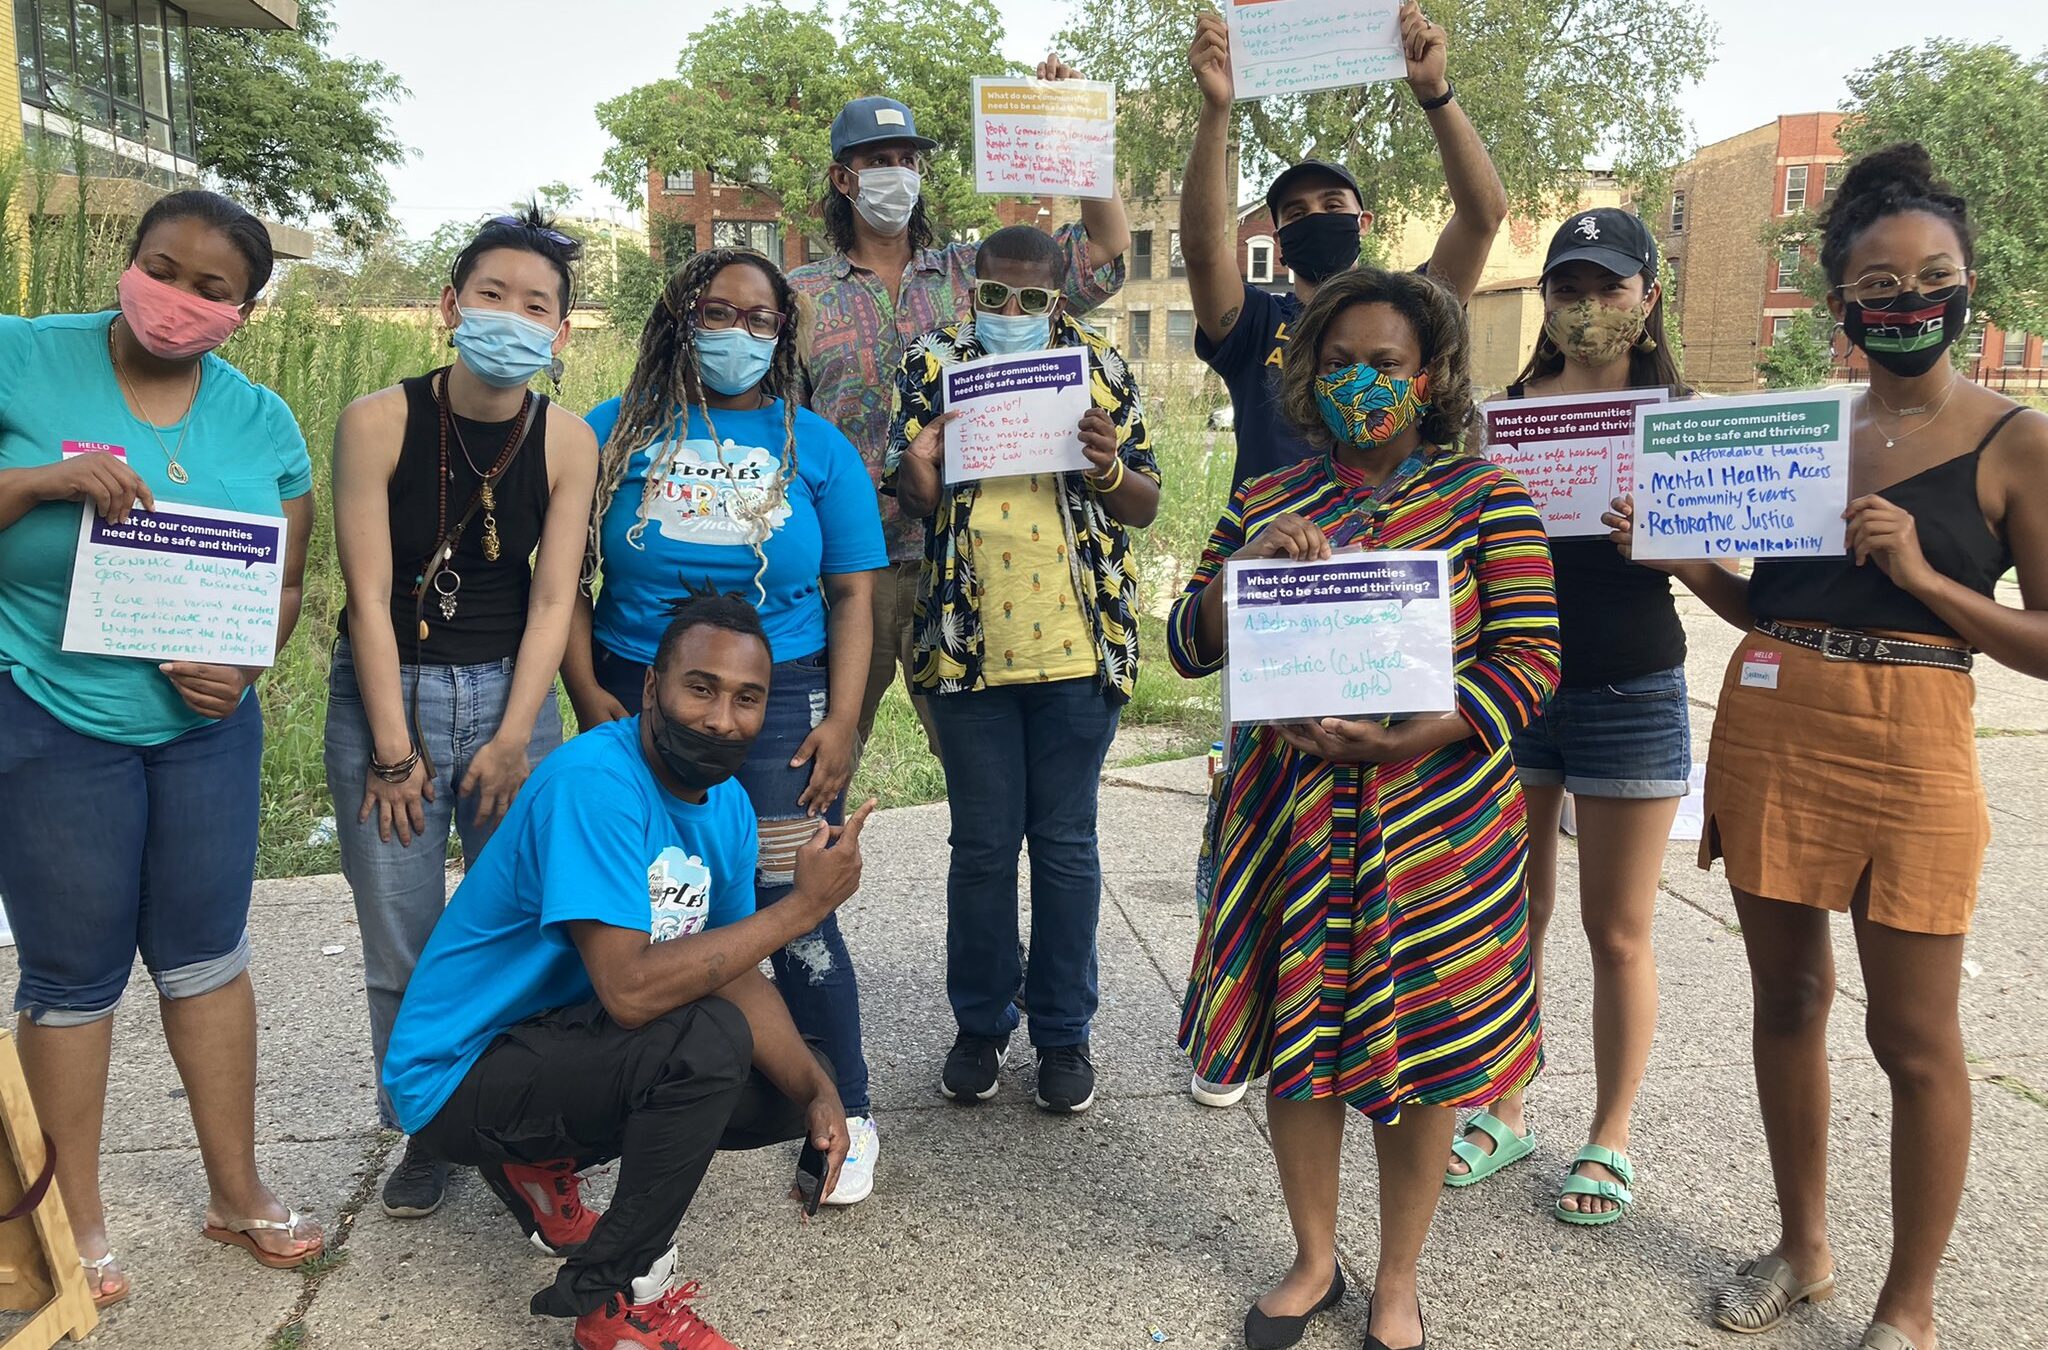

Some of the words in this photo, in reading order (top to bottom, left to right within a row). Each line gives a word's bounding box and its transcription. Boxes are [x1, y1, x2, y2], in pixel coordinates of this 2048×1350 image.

[1241, 67, 1255, 79] I
[987, 91, 1009, 100] What
[1010, 91, 1020, 100] do
[987, 102, 1008, 110] need
[986, 170, 995, 181] I
[954, 374, 974, 386] What
[975, 373, 985, 381] do
[986, 369, 1000, 379] our
[1001, 363, 1060, 376] communities
[954, 385, 974, 396] need
[974, 384, 983, 392] to
[984, 381, 995, 390] be
[996, 377, 1015, 388] safe
[1016, 375, 1033, 385] and
[1034, 372, 1077, 383] thriving?
[1495, 415, 1523, 426] What
[1524, 414, 1538, 423] do
[1540, 413, 1559, 422] our
[1560, 408, 1632, 421] communities
[1652, 420, 1681, 432] What
[1683, 419, 1698, 428] do
[1700, 418, 1722, 428] our
[1723, 412, 1806, 426] communities
[1495, 428, 1522, 438] need
[1523, 427, 1535, 436] to
[1537, 426, 1551, 435] be
[1552, 423, 1577, 434] safe
[1578, 422, 1599, 432] and
[1600, 419, 1635, 430] thrivi
[1652, 433, 1680, 445] need
[1682, 433, 1695, 443] to
[1697, 431, 1712, 442] be
[1714, 429, 1741, 441] safe
[1743, 427, 1767, 439] and
[1769, 423, 1830, 438] thriving?
[78, 442, 110, 451] HELLO
[1721, 465, 1780, 486] Health
[1788, 460, 1831, 480] Access
[1667, 489, 1743, 509] Community
[1747, 487, 1797, 503] Events
[1742, 505, 1795, 531] Justice
[140, 517, 156, 529] do
[158, 521, 180, 531] our
[181, 525, 253, 540] communities
[102, 527, 135, 540] need
[137, 530, 151, 542] to
[153, 532, 169, 544] be
[171, 535, 196, 547] safe
[198, 538, 219, 550] and
[221, 541, 271, 557] thriving?
[1705, 540, 1710, 553] I
[1246, 576, 1279, 586] What
[1281, 574, 1297, 584] do
[1299, 574, 1321, 583] our
[1322, 568, 1406, 581] communities
[1247, 588, 1278, 599] need
[1279, 587, 1294, 598] to
[1295, 586, 1312, 596] be
[1313, 584, 1342, 595] safe
[1343, 583, 1368, 594] and
[1370, 581, 1430, 593] thriving?
[1753, 651, 1774, 659] HELLO
[658, 883, 707, 908] PLE'S
